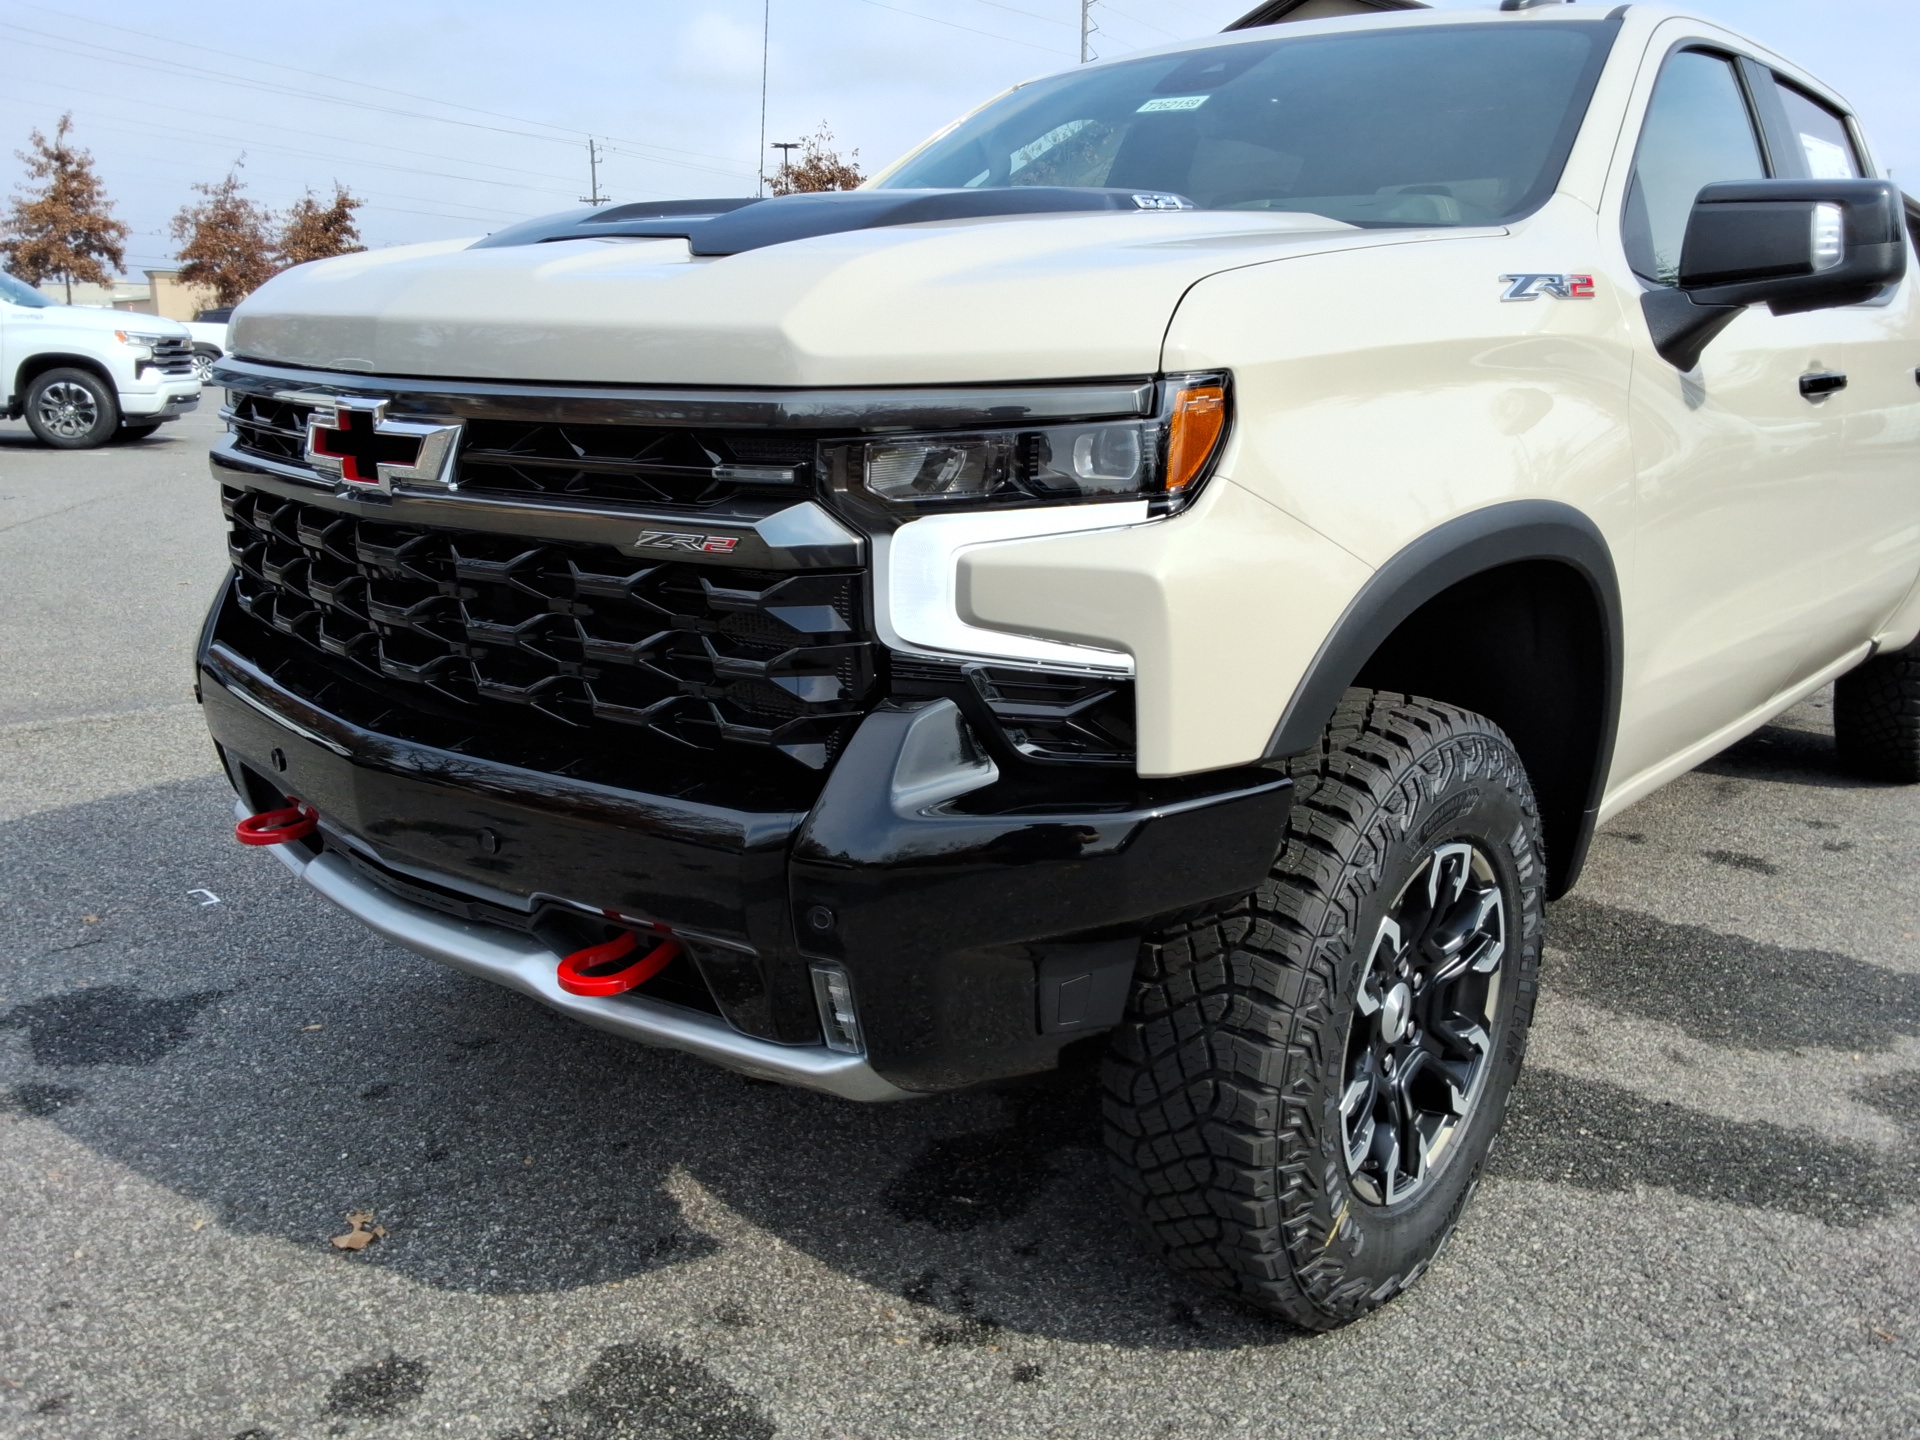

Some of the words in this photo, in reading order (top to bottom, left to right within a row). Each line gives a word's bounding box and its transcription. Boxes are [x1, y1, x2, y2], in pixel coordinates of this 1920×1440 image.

[1498, 274, 1595, 302] ZR2
[634, 530, 740, 554] ZR2
[1503, 820, 1538, 1066] WRANGLER
